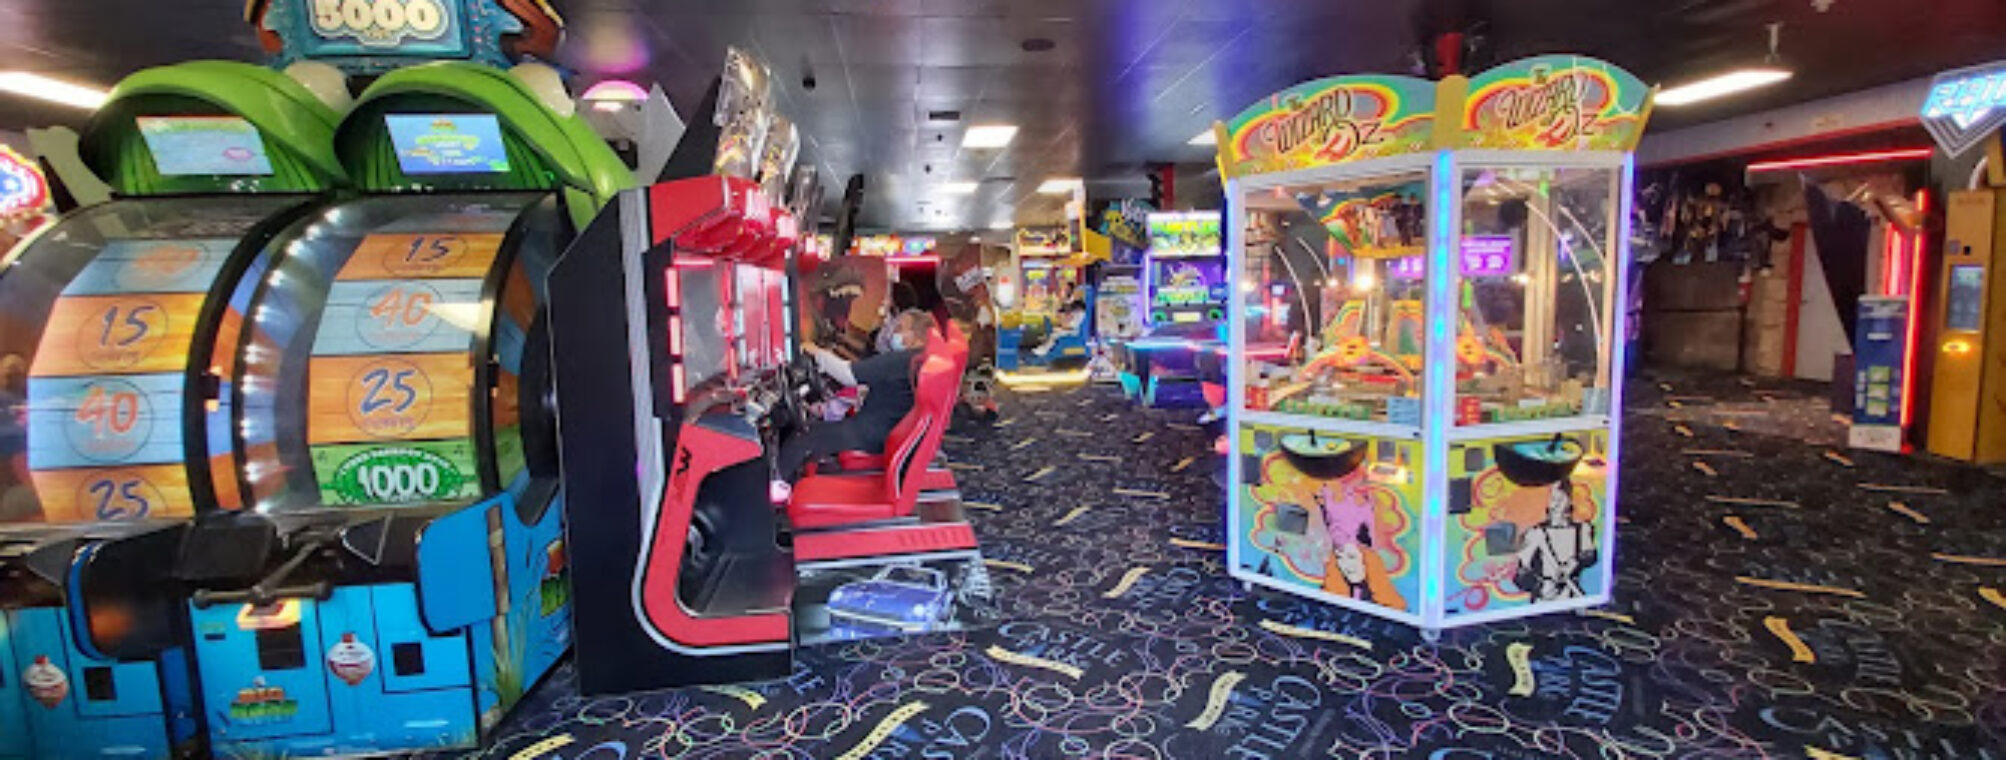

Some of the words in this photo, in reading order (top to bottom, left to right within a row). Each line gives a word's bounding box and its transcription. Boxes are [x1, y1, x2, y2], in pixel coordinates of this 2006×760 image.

[314, 0, 441, 31] 5000
[1263, 87, 1352, 154] WIZARD
[1496, 71, 1588, 130] WIZARD
[404, 234, 459, 263] 15
[100, 304, 156, 347] 15
[370, 287, 434, 328] 40
[360, 366, 418, 415] 25
[75, 386, 139, 439] 40
[89, 478, 150, 520] 25
[358, 461, 440, 498] 1000
